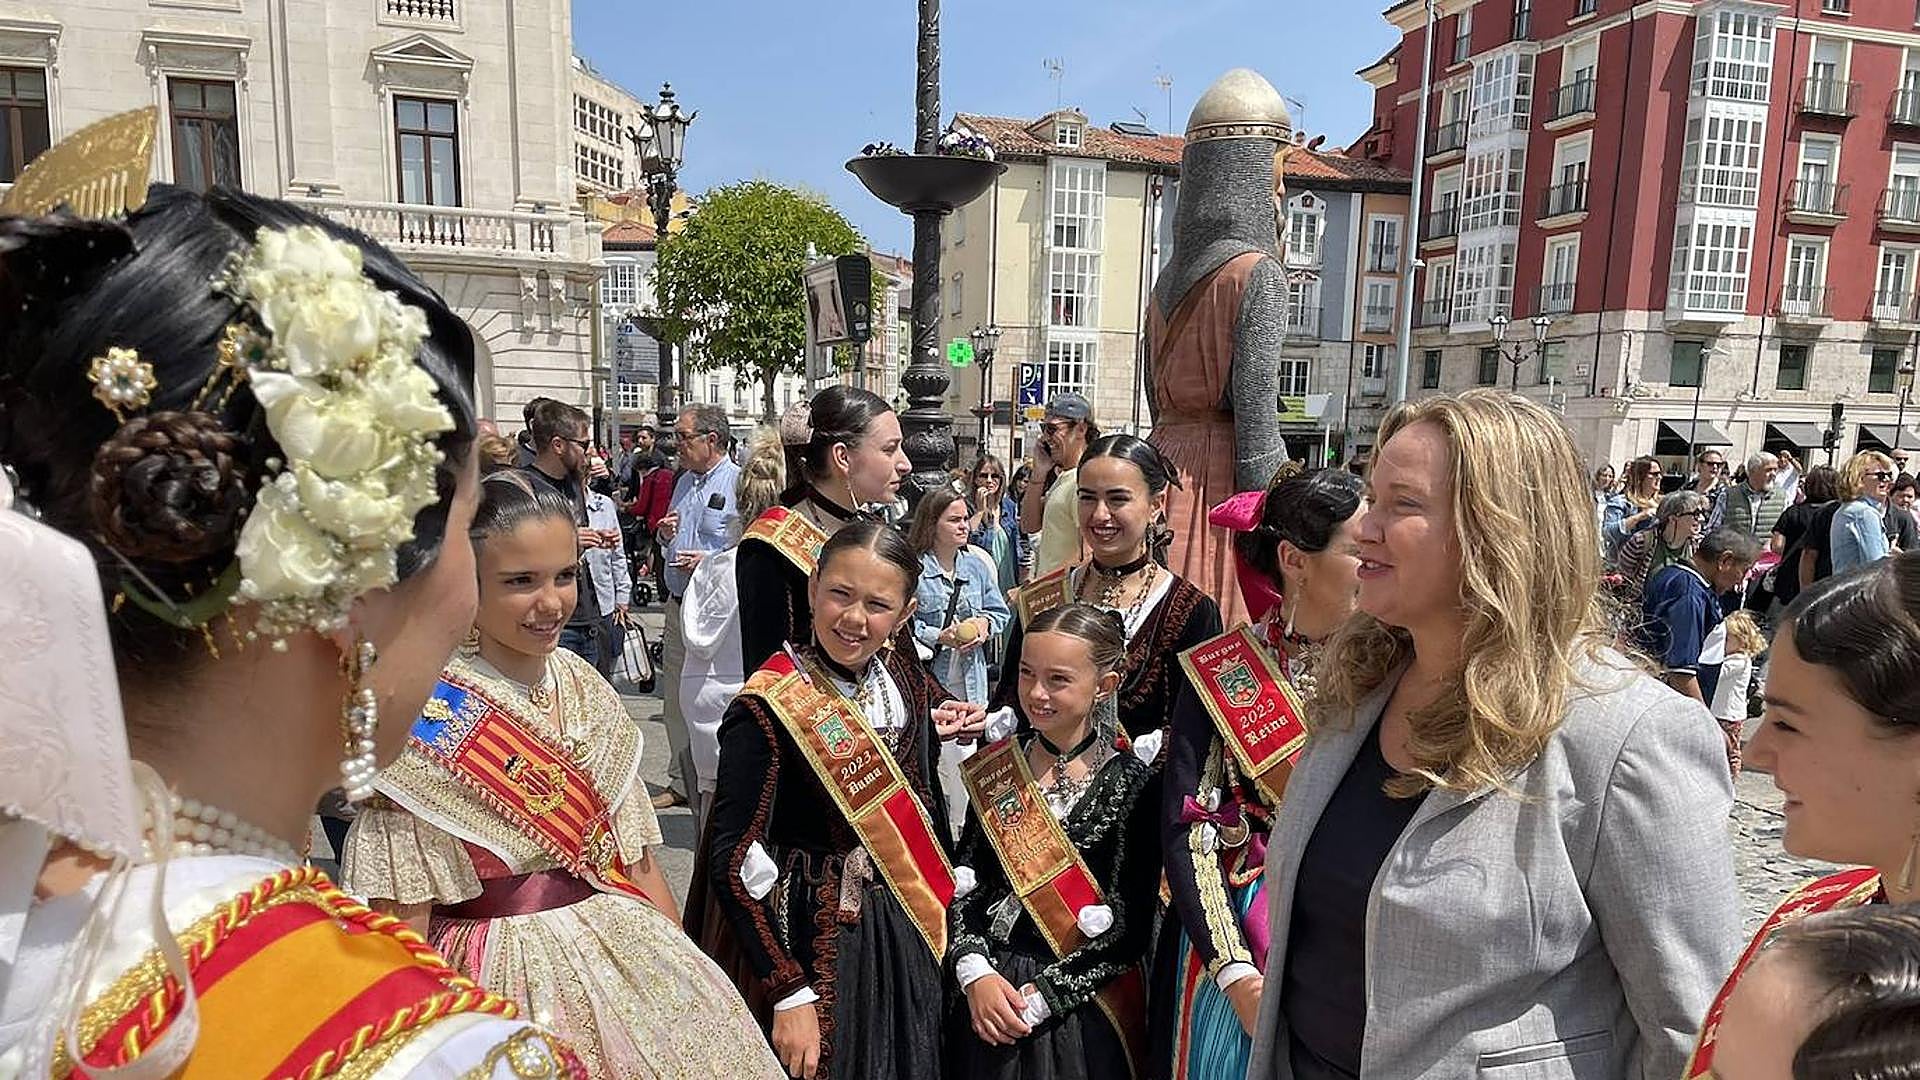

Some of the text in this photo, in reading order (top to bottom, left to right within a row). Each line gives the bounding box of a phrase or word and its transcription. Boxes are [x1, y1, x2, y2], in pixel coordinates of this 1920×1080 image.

[1022, 366, 1033, 384] P
[1197, 641, 1242, 664] Burgos
[1240, 699, 1276, 729] 2023
[1244, 716, 1289, 747] Reina
[841, 751, 873, 780] 2023
[847, 768, 883, 796] Dama
